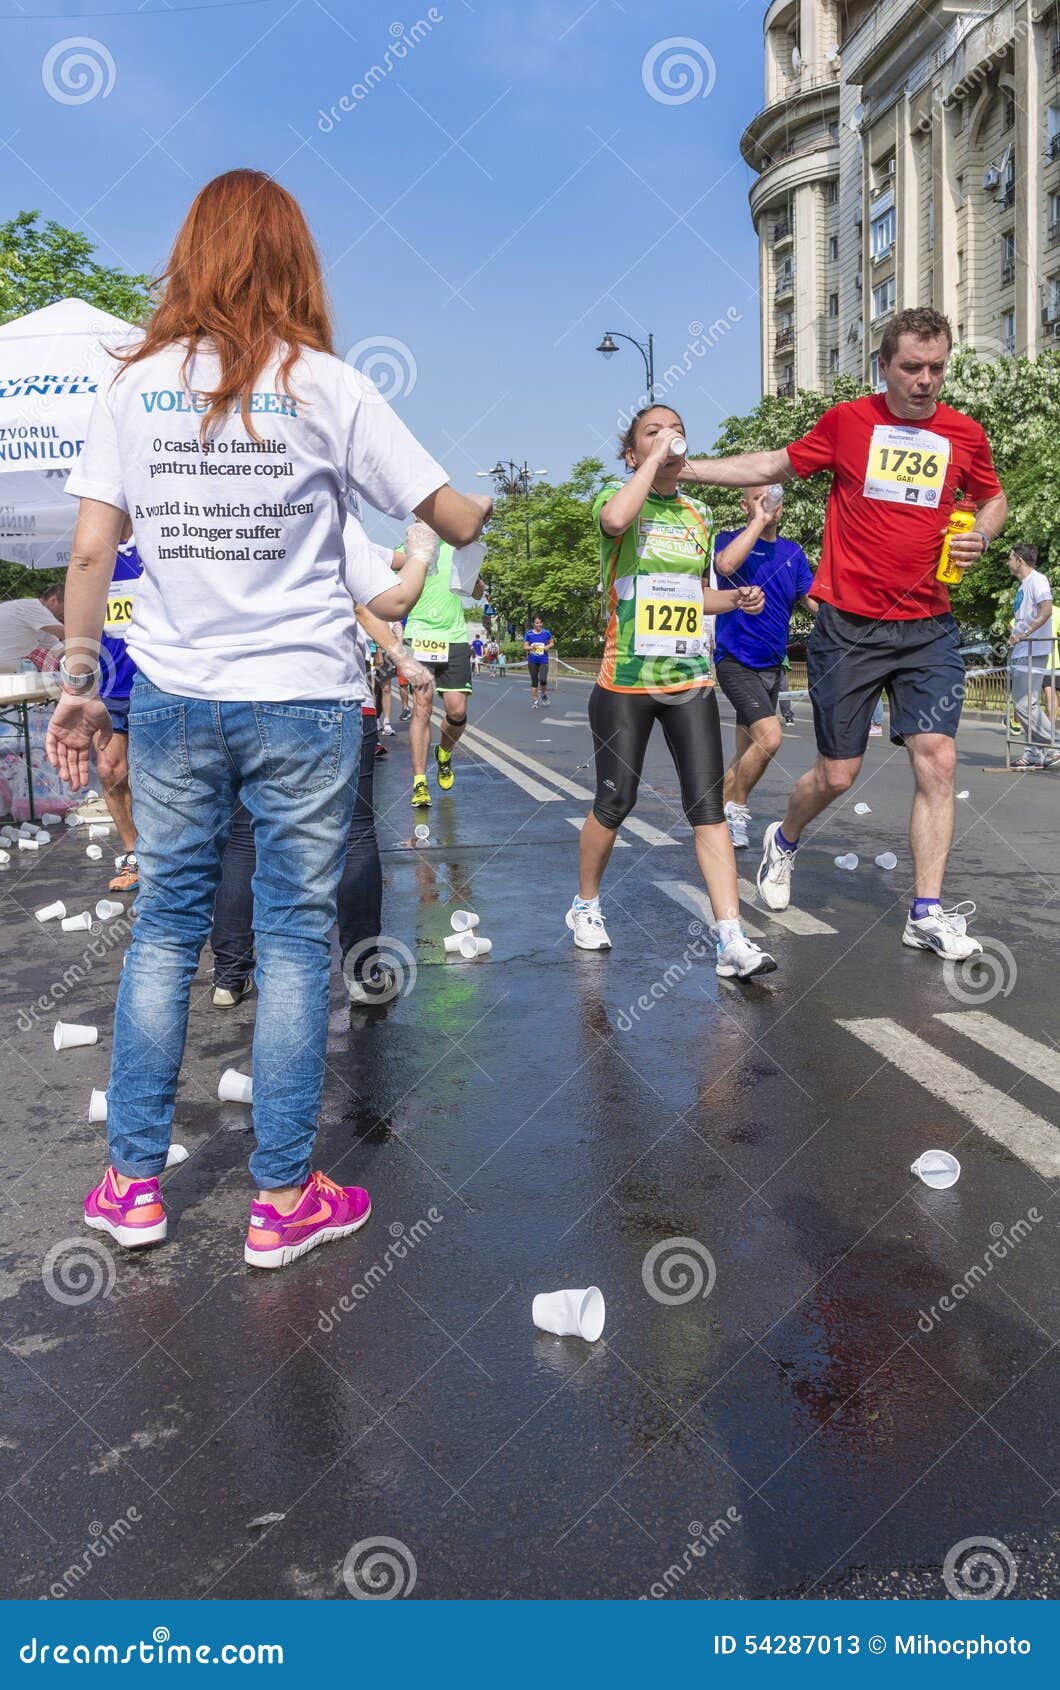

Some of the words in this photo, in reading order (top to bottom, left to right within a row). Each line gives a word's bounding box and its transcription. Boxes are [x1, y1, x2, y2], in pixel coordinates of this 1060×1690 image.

[0, 375, 95, 386] VORUL
[153, 438, 162, 452] O
[164, 440, 199, 453] casă
[218, 443, 228, 454] o
[231, 440, 287, 454] familie
[150, 461, 197, 478] pentru
[200, 461, 251, 476] fiecare
[254, 463, 294, 478] copil
[880, 448, 938, 478] 1736
[896, 474, 915, 483] GABI
[135, 505, 145, 519] A
[145, 501, 180, 516] world
[184, 502, 200, 516] in
[202, 503, 250, 518] which
[254, 502, 314, 518] children
[161, 525, 180, 537] no
[183, 523, 233, 541] longer
[236, 525, 282, 539] suffer
[158, 545, 250, 561] institutional
[253, 547, 286, 560] care
[645, 605, 698, 633] 1278
